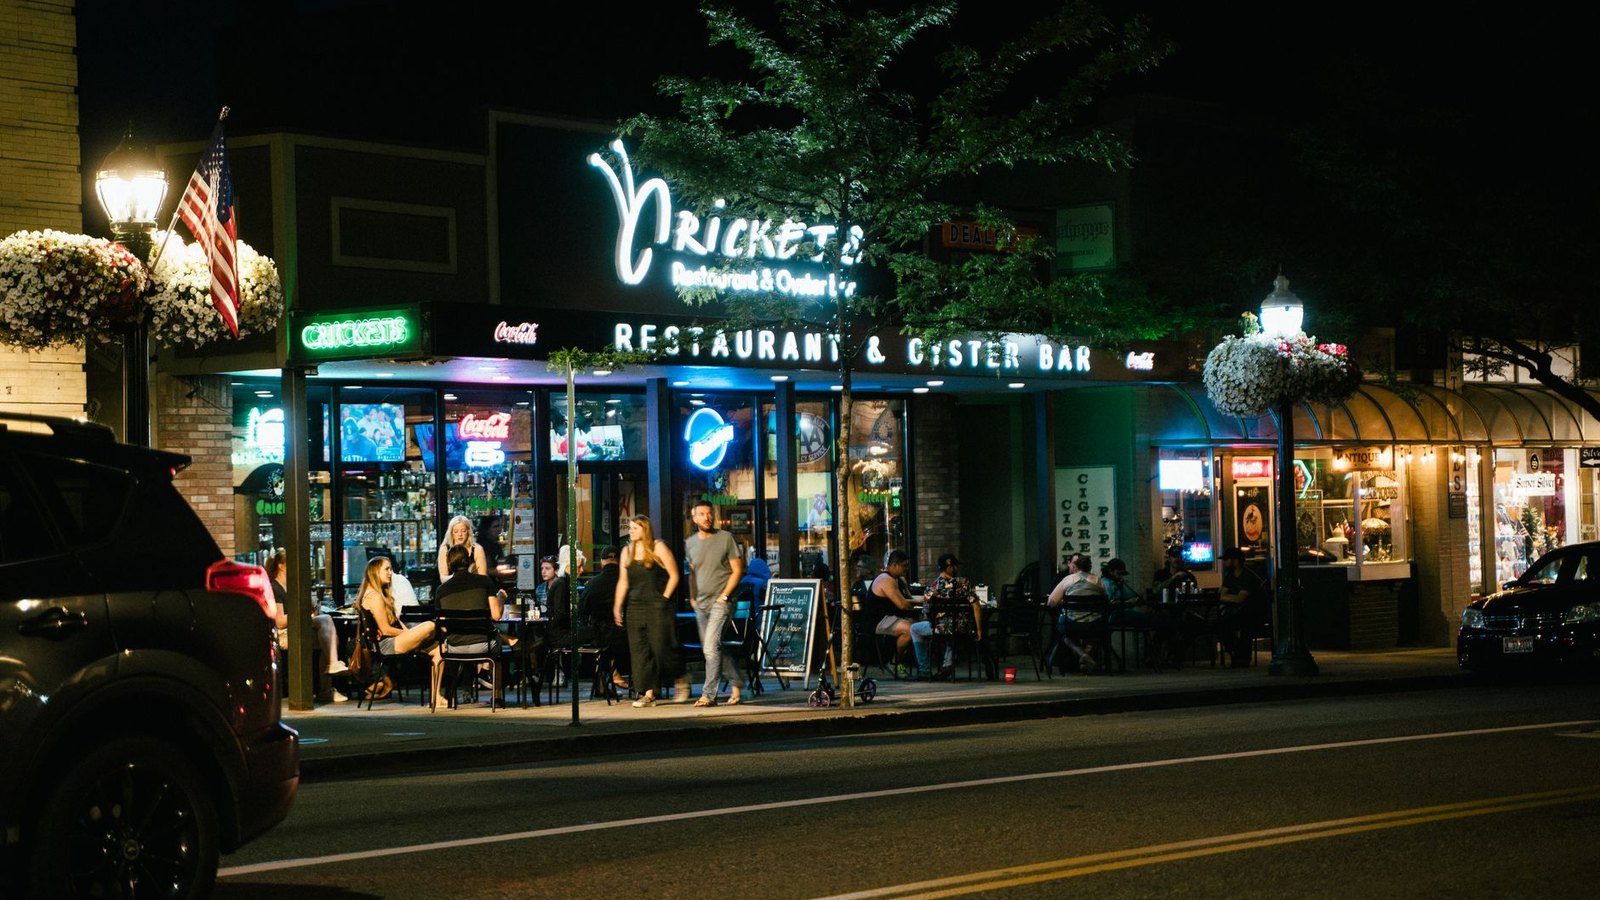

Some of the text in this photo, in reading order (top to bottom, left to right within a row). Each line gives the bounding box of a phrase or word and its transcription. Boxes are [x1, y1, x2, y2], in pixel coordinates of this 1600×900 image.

[586, 138, 864, 285] CRICKETS
[672, 261, 758, 291] Restaurant
[759, 268, 774, 290] &
[301, 317, 408, 350] CRICKETS
[613, 322, 1091, 372] RESTAURANT & OYSTER BAR
[459, 412, 512, 439] Coca-Cola
[1516, 476, 1555, 489] Super Silver
[1077, 473, 1090, 553] CIGARE
